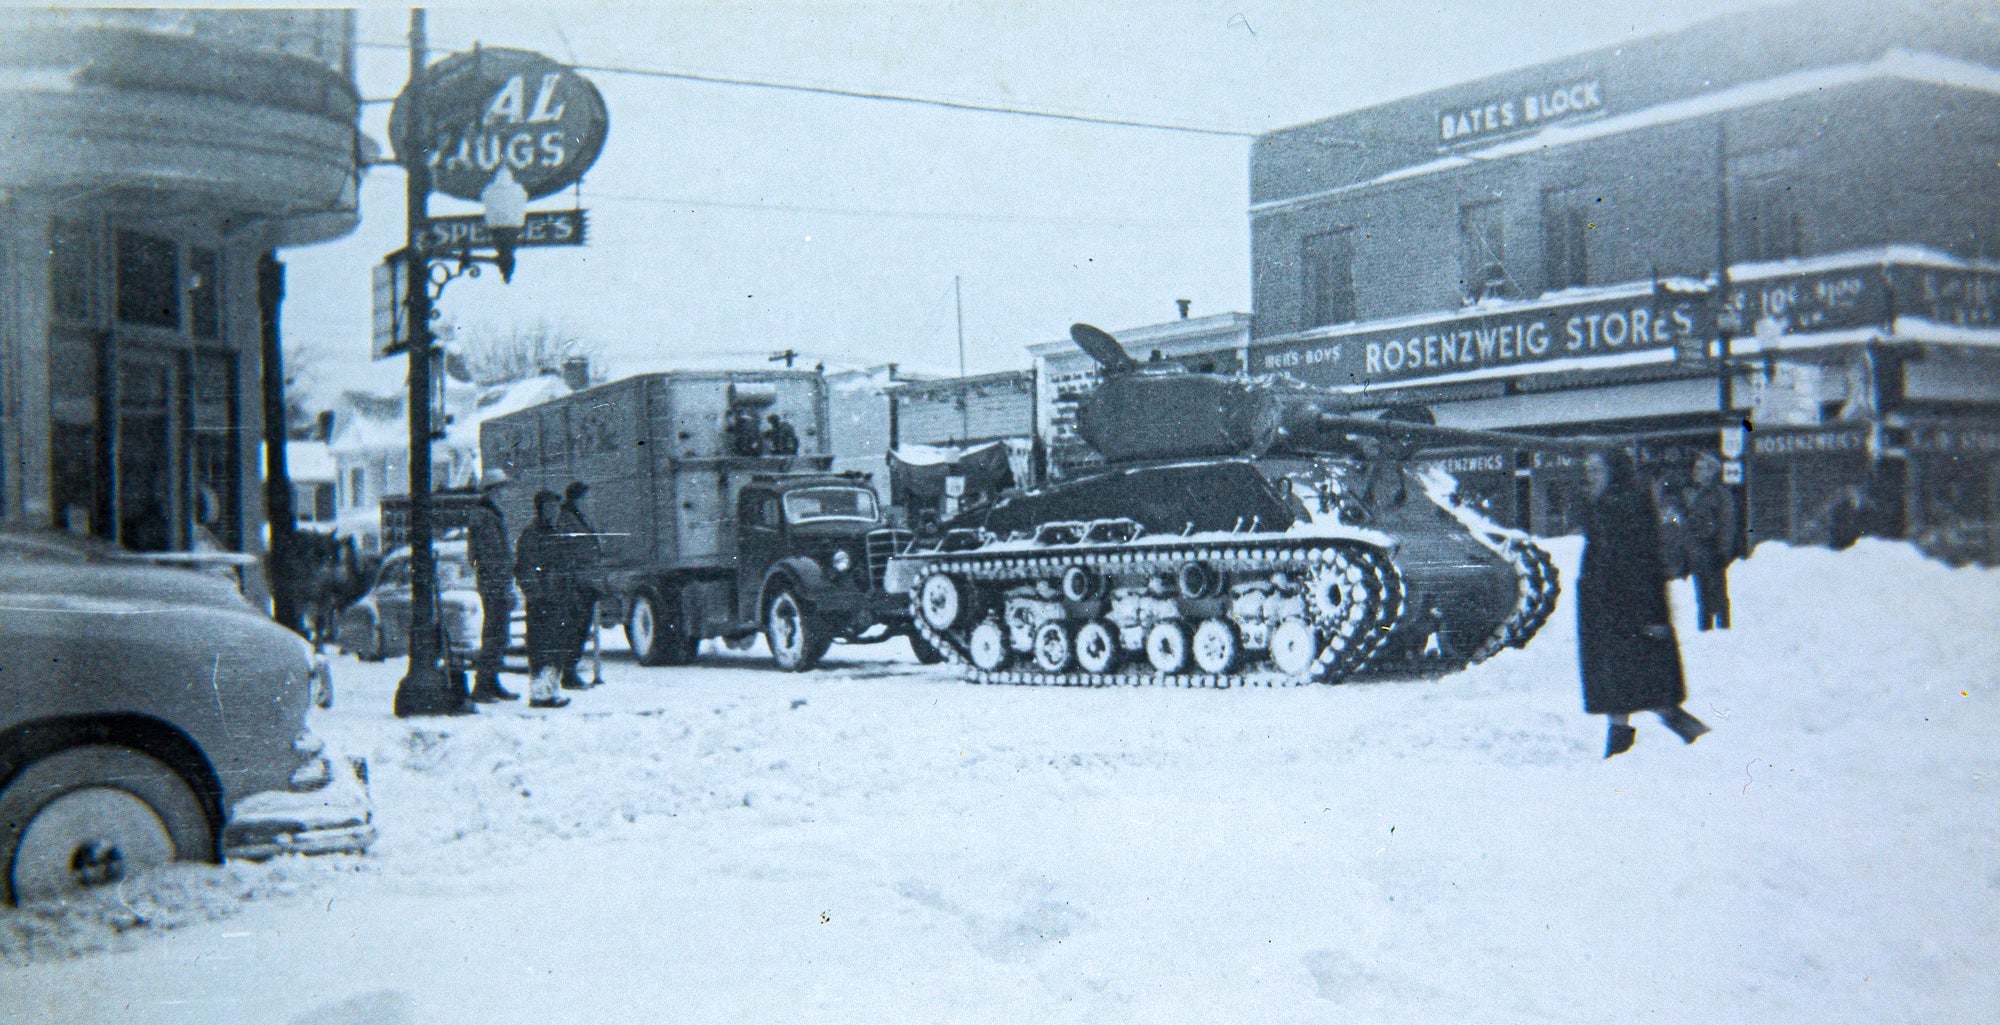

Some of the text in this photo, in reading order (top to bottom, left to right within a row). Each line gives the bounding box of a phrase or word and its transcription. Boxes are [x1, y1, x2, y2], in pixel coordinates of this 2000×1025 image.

[1441, 79, 1601, 141] BATES BLOCK
[431, 213, 574, 244] SPEE'S
[1365, 303, 1692, 374] ROSENZWEIG STORES
